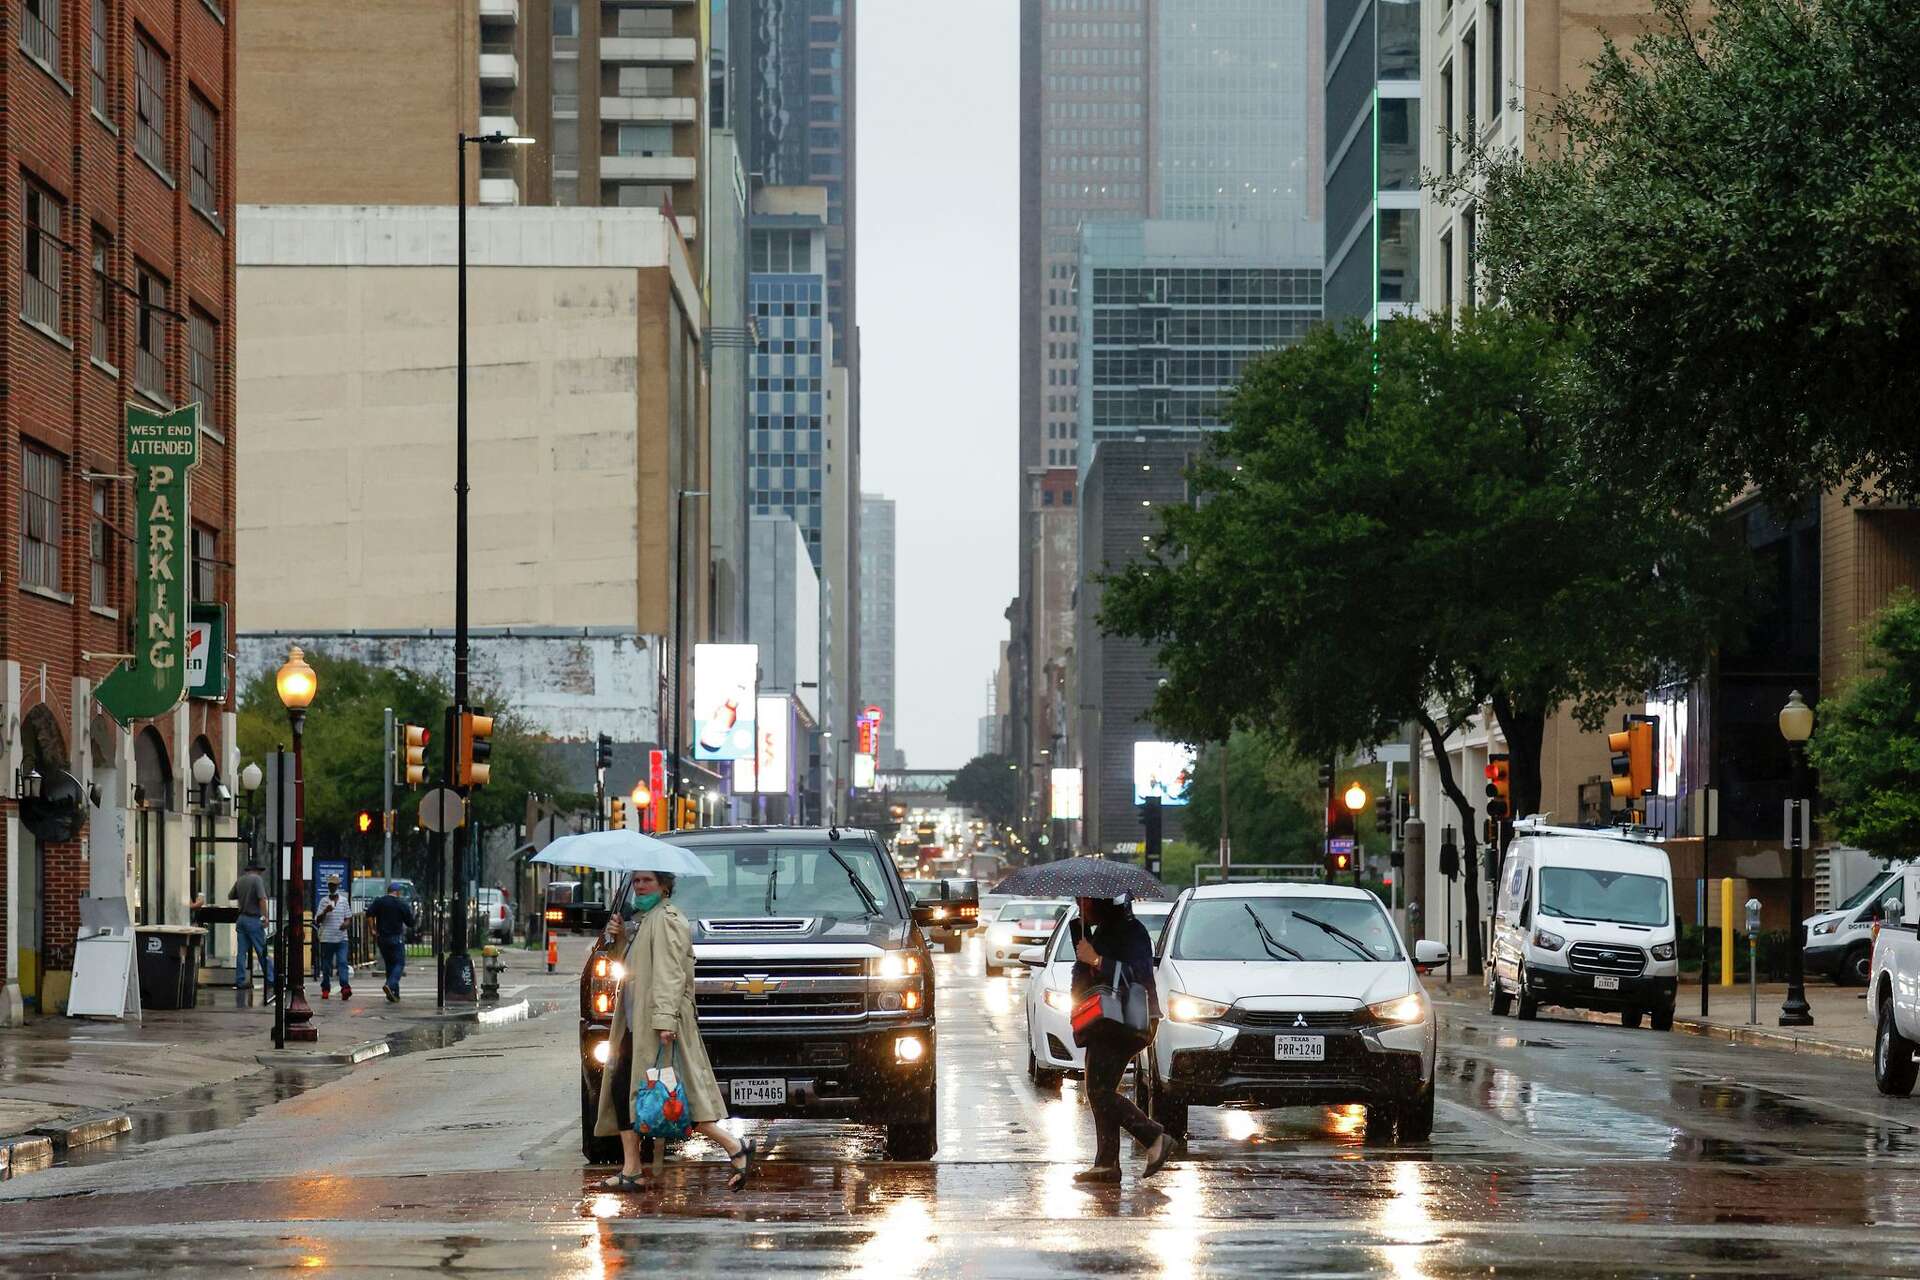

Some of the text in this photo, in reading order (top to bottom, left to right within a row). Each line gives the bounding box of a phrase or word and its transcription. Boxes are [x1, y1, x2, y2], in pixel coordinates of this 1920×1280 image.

[130, 425, 192, 436] WEST END
[131, 440, 193, 455] ATTENDED
[148, 465, 176, 669] PARKING
